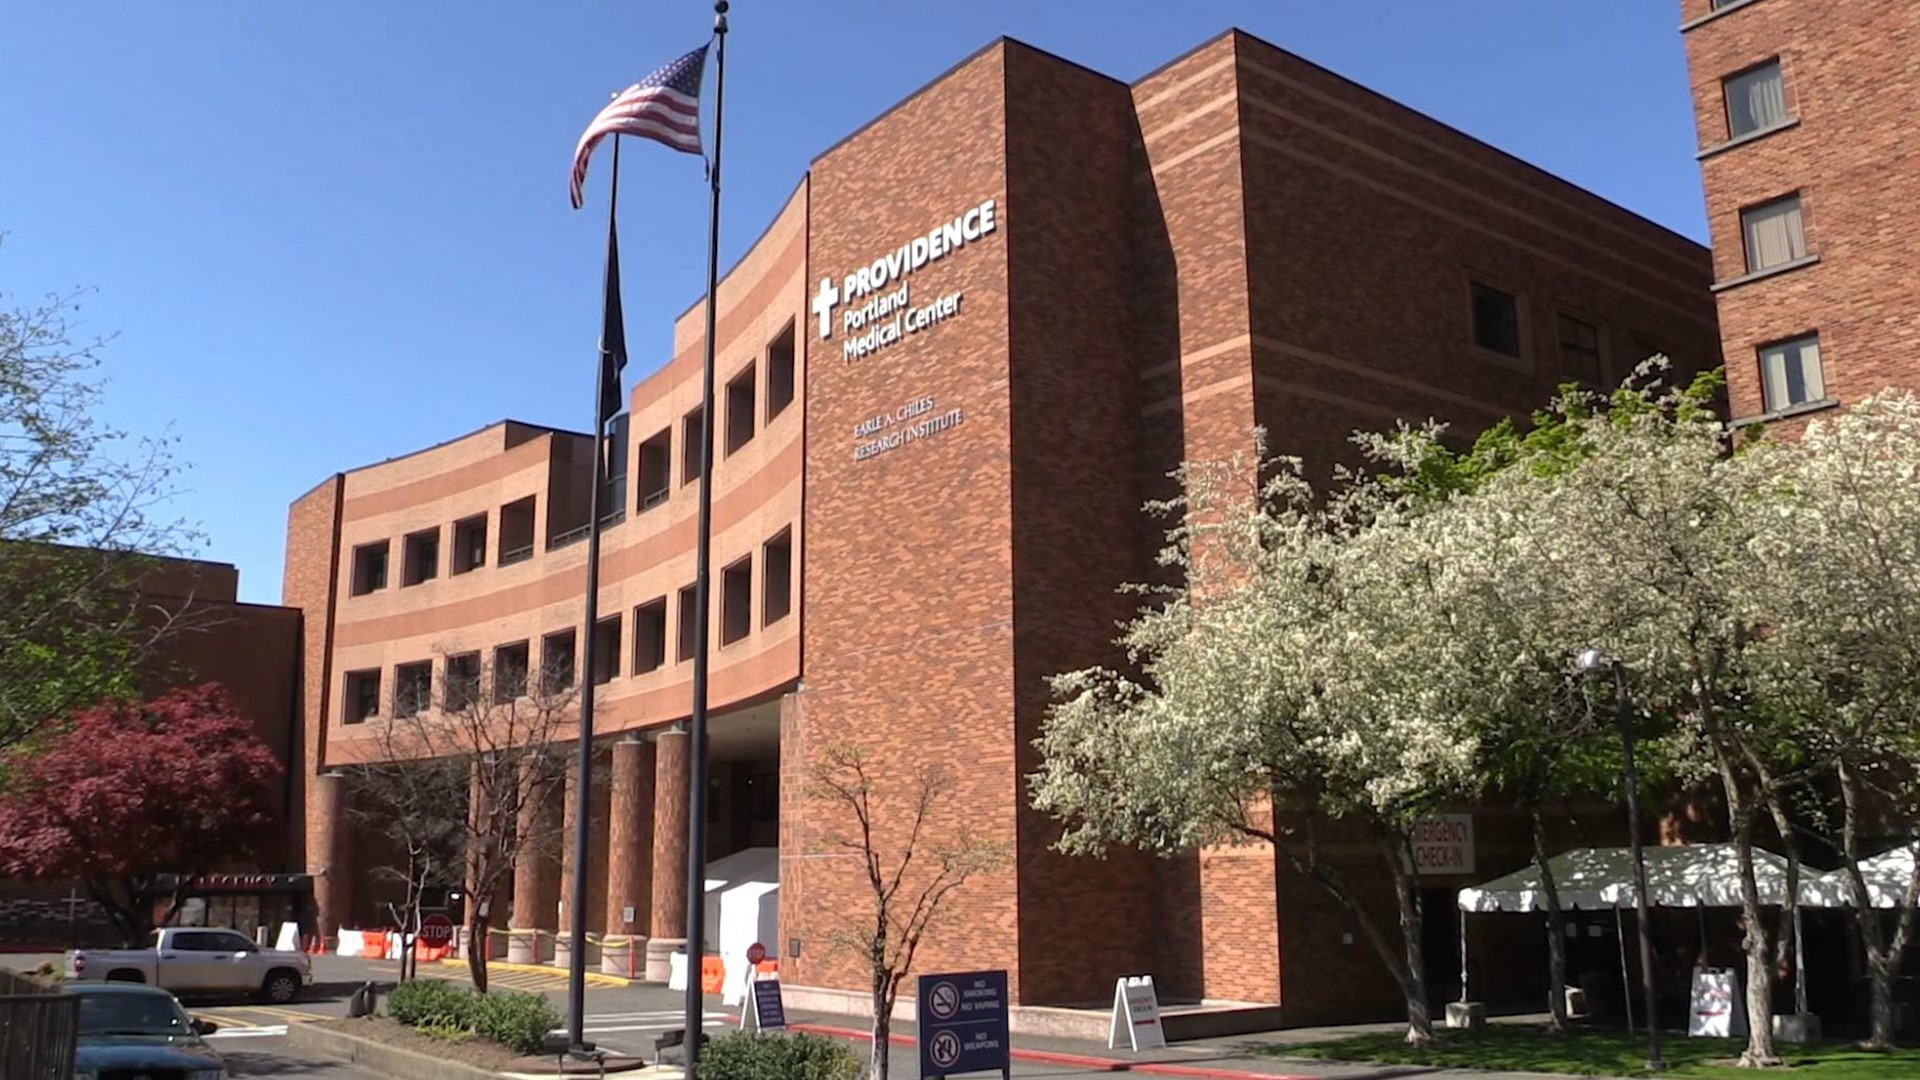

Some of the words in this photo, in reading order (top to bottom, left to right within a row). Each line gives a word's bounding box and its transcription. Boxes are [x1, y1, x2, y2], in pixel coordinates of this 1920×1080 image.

[843, 200, 996, 303] PROVIDENCE
[843, 281, 909, 332] Portland
[843, 315, 902, 361] Medical
[904, 292, 962, 332] Center
[853, 415, 883, 438] EARLE
[884, 412, 896, 427] A.
[896, 396, 934, 421] CHILES
[854, 431, 905, 461] RESEARCH
[904, 408, 964, 442] INSTITUTE
[1408, 820, 1468, 842] MERGENCY
[1416, 846, 1463, 868] CHECK-IN
[423, 925, 451, 938] STOP
[963, 988, 998, 998] SMOKING
[973, 980, 986, 988] NO
[961, 1002, 973, 1011] NO
[974, 1001, 1000, 1010] VAPING
[963, 1040, 999, 1051] WEAPONS
[975, 1032, 988, 1041] NO
